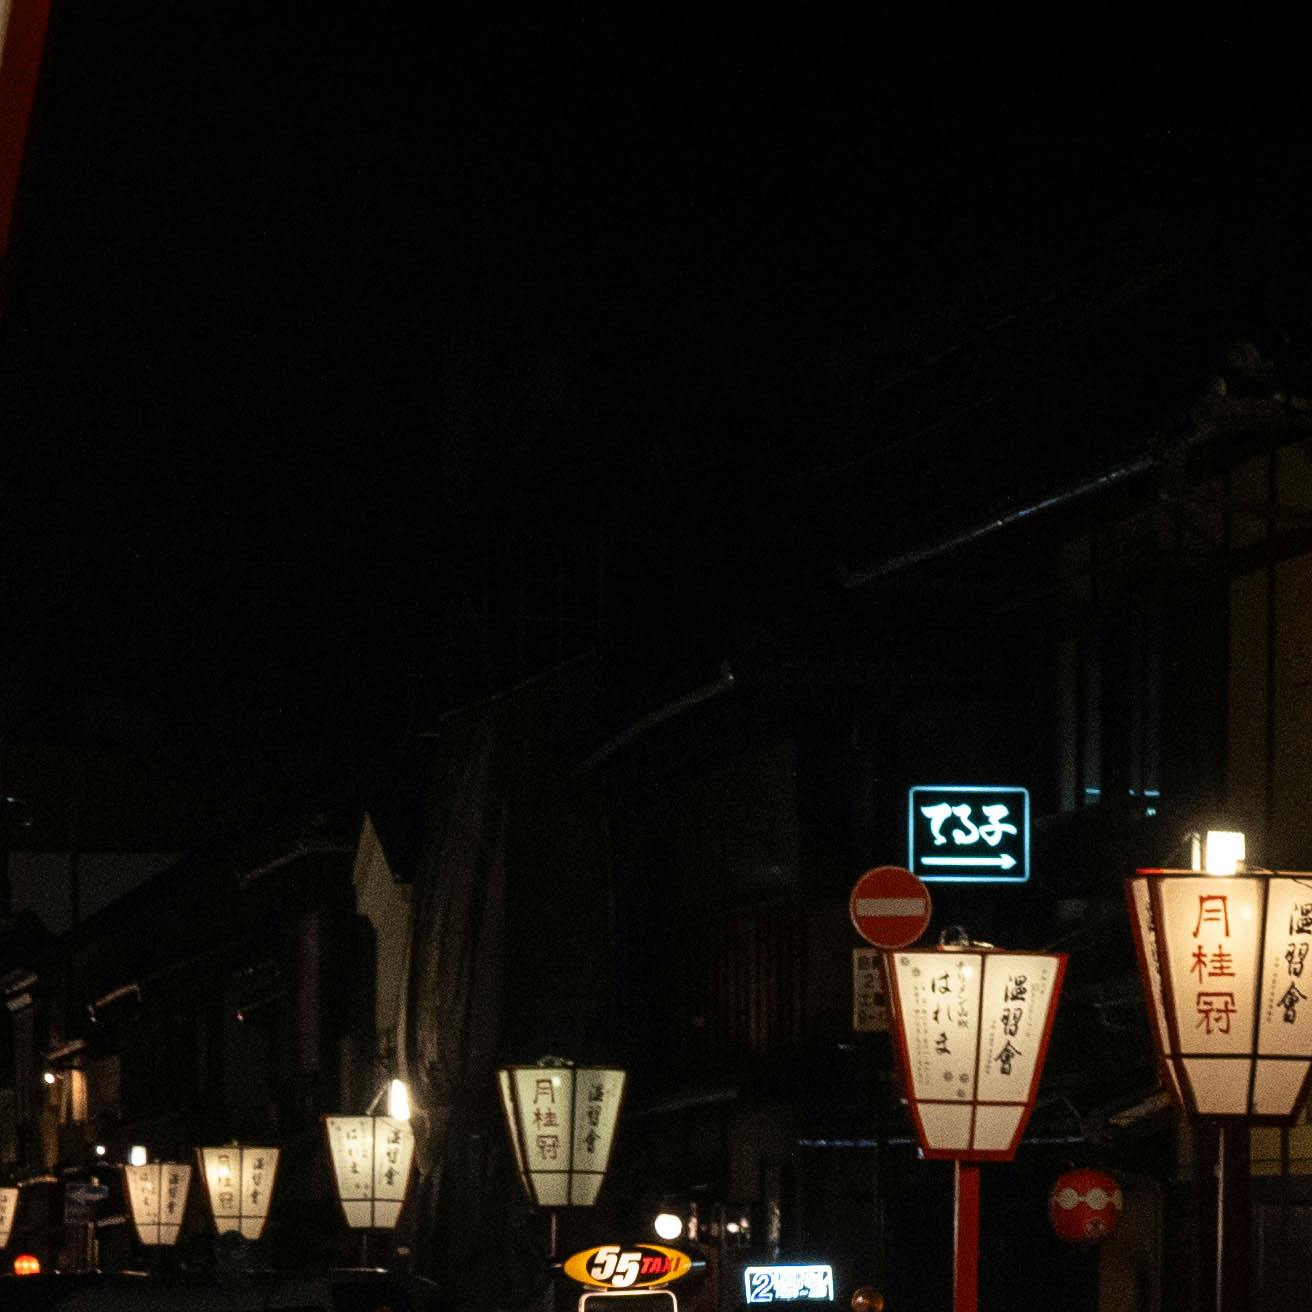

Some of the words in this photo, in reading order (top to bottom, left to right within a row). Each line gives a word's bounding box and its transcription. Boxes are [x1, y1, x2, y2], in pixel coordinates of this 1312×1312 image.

[920, 802, 1018, 847] てる子
[1190, 894, 1237, 1035] 月桂冠
[532, 1078, 560, 1161] 月桂冠
[590, 1245, 642, 1288] 55
[640, 1256, 681, 1274] TAXI
